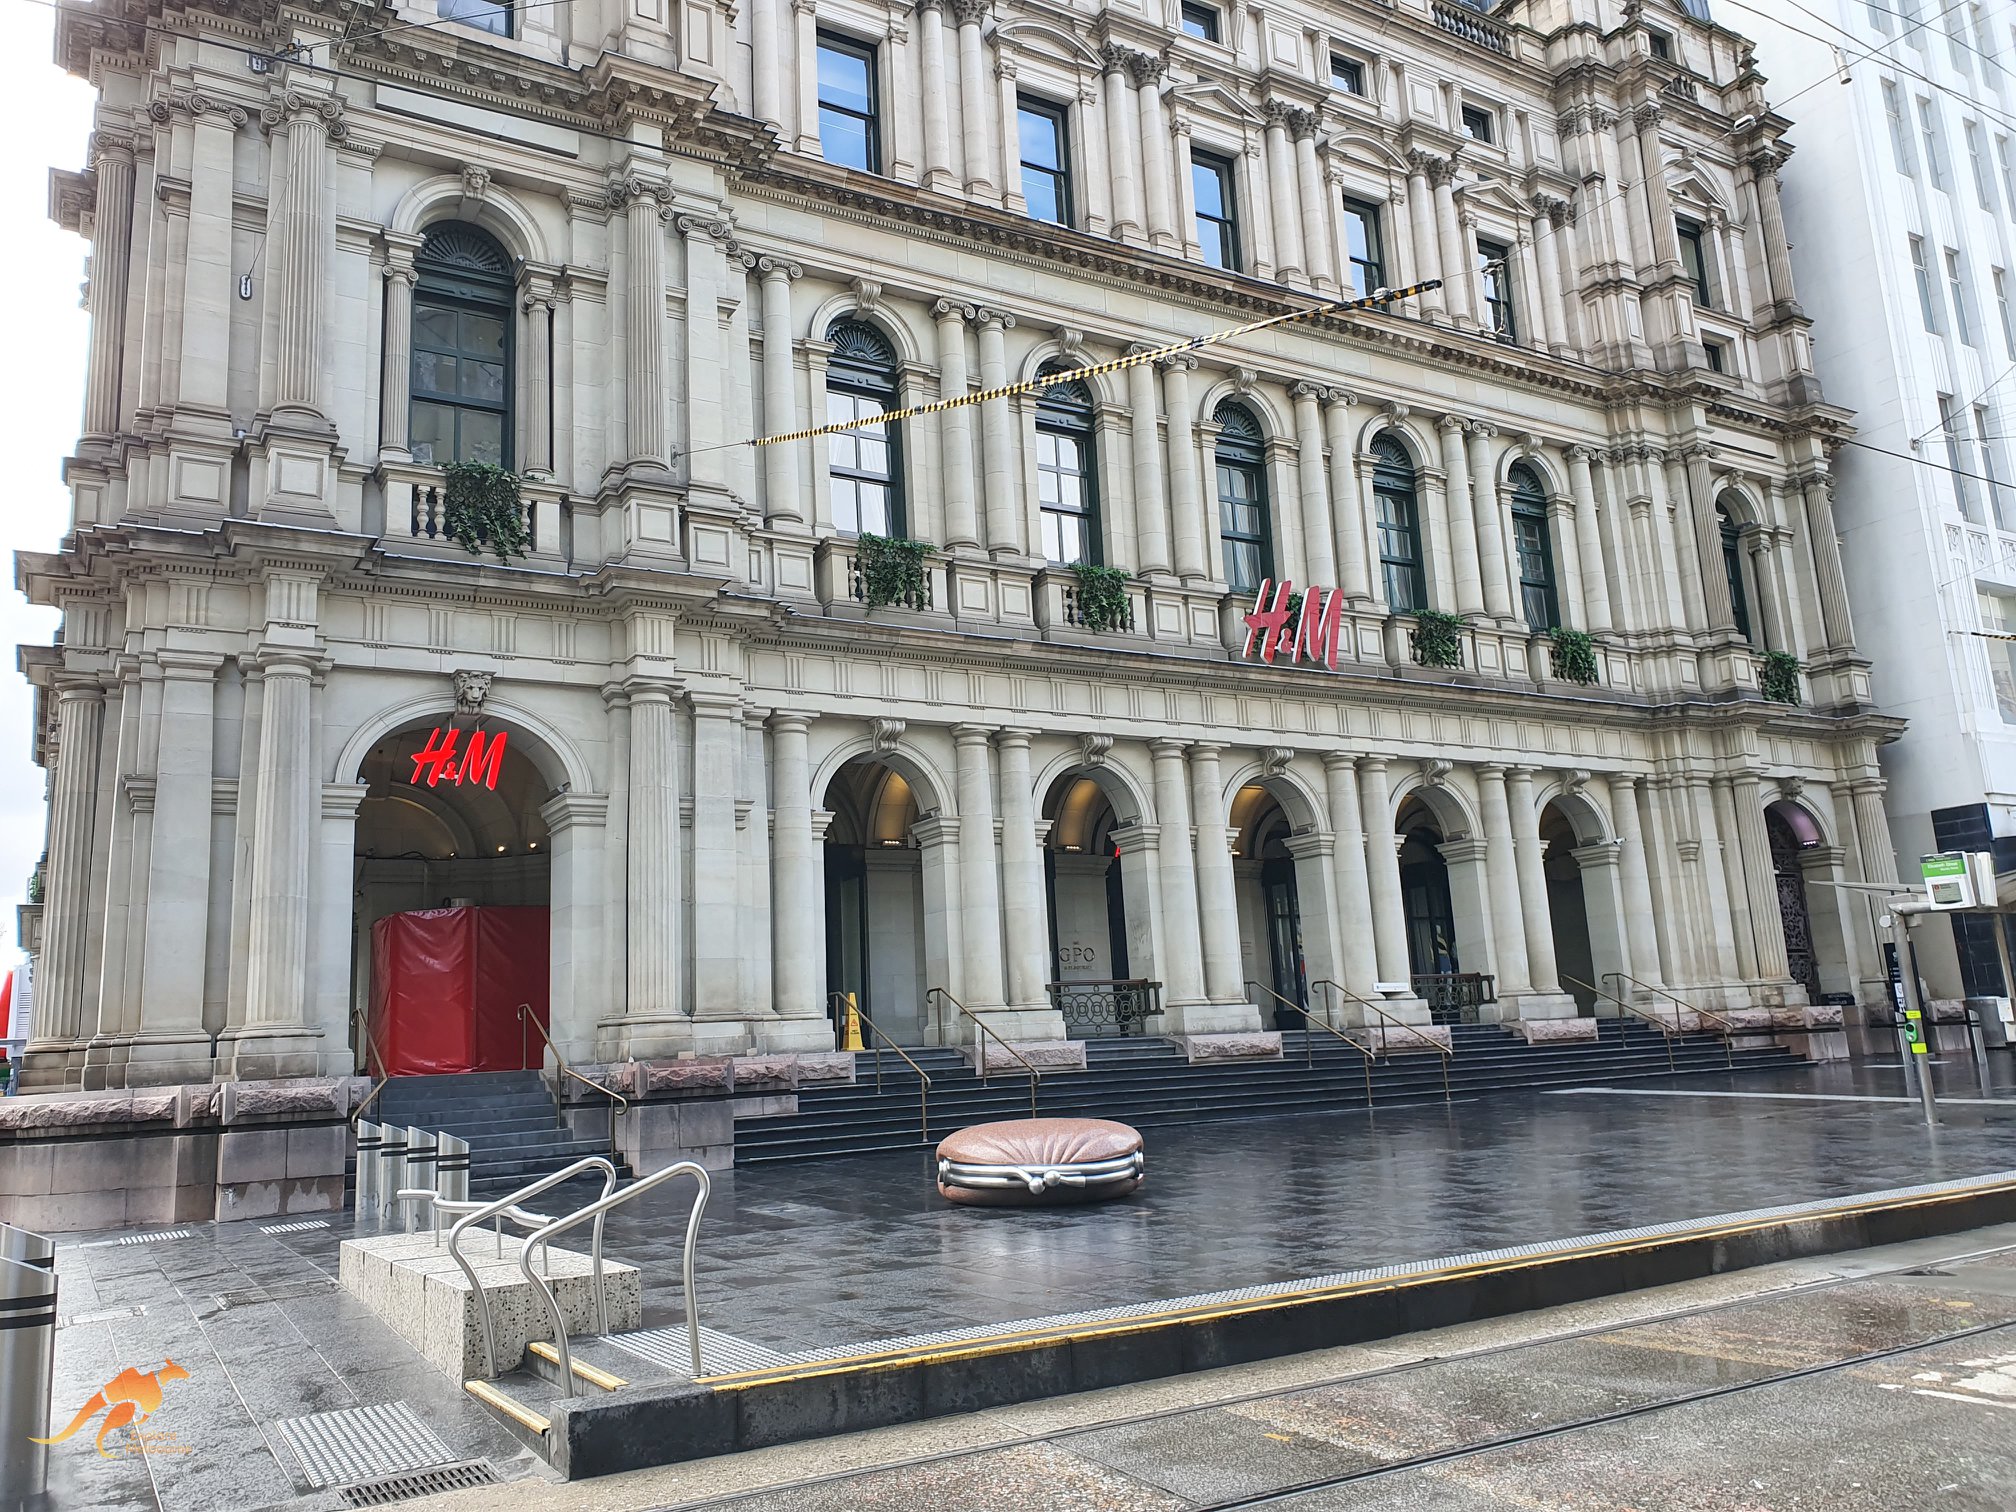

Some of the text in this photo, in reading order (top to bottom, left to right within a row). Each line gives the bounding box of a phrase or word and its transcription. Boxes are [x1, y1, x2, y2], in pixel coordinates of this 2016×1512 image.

[1240, 578, 1344, 671] H&M
[411, 728, 508, 790] H&M
[1060, 947, 1095, 962] GPO
